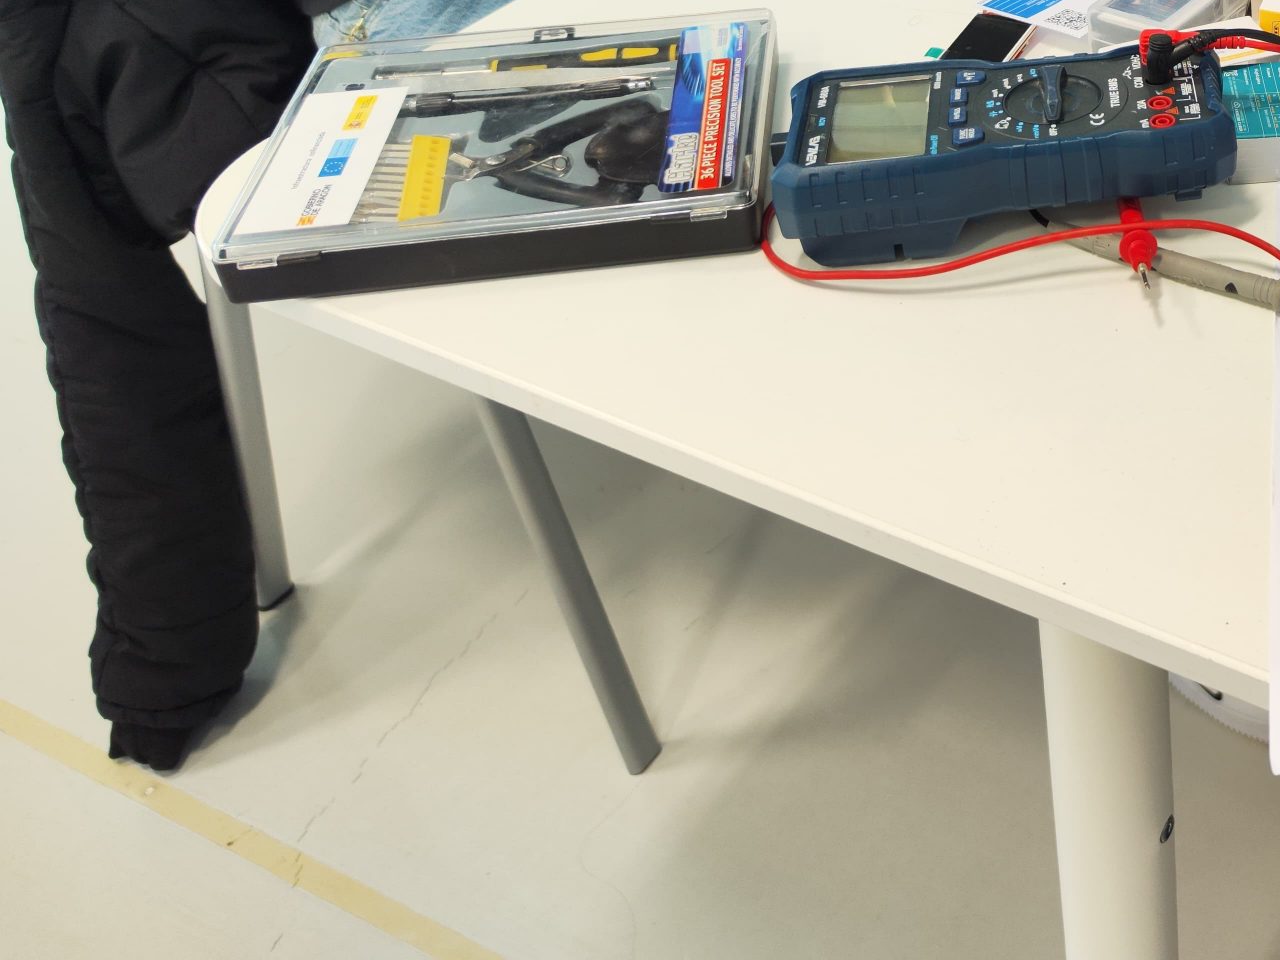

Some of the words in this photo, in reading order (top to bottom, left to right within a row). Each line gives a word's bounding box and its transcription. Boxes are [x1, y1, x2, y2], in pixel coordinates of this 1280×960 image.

[711, 62, 726, 76] SET
[709, 76, 724, 97] TOOL
[1109, 91, 1121, 108] TRUE
[704, 98, 721, 142] PRECISION
[701, 142, 717, 164] PIECE
[700, 164, 715, 181] 36
